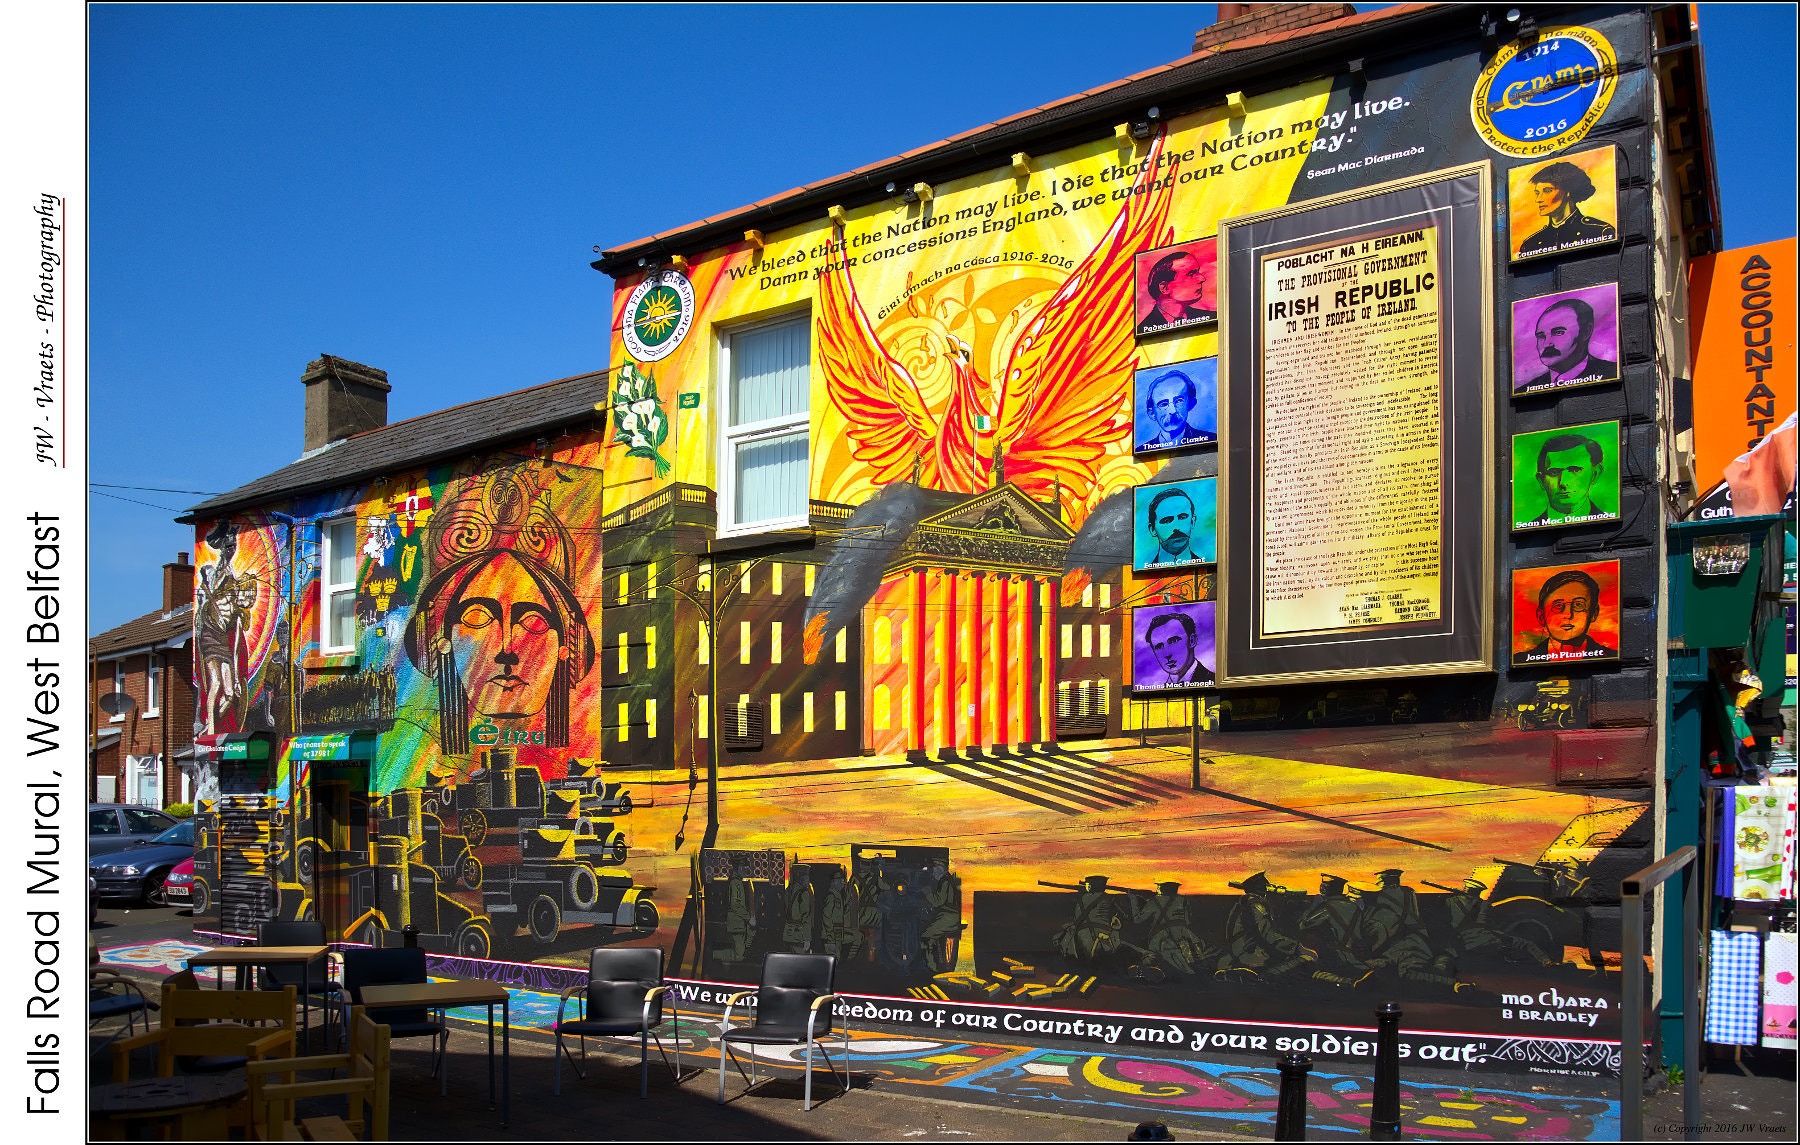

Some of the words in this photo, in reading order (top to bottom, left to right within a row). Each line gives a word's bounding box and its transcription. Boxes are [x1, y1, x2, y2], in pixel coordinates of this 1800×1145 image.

[1544, 30, 1564, 39] na
[1522, 41, 1560, 62] 1914
[1482, 127, 1529, 155] Protect
[1531, 143, 1556, 154] the
[1556, 101, 1605, 147] Republic
[1523, 119, 1568, 139] 2016
[1306, 165, 1336, 180] Sean
[1337, 159, 1363, 174] Mac
[1365, 146, 1425, 167] Diarmada
[724, 263, 757, 281] "We
[761, 250, 805, 272] bleed
[810, 237, 847, 260] that
[851, 229, 882, 250] the
[887, 211, 949, 239] Nation
[955, 200, 998, 223] may
[1003, 189, 1045, 209] live.
[1051, 181, 1057, 196] I
[1061, 174, 1094, 193] die
[1100, 163, 1149, 184] that
[1156, 148, 1195, 170] the
[1201, 129, 1284, 158] Nation
[1290, 110, 1347, 137] may
[1354, 94, 1411, 120] live.
[760, 269, 808, 291] Damn
[812, 258, 857, 280] your
[862, 227, 978, 264] concessions
[982, 203, 1068, 234] England,
[1072, 193, 1106, 212] we
[1111, 173, 1173, 202] want
[1179, 163, 1224, 185] our
[1230, 126, 1357, 171] Country."
[1278, 250, 1334, 271] POBLACHT
[1341, 246, 1355, 258] NA
[1362, 242, 1369, 254] H
[1375, 231, 1424, 251] EIREANN.
[1514, 243, 1558, 260] Countess
[902, 270, 942, 299] amach
[945, 263, 961, 275] na
[1002, 251, 1075, 270] 1916-2016
[1278, 278, 1295, 292] THE
[1301, 265, 1358, 288] PROVISIONAL
[1364, 250, 1428, 275] GOVERNMENT
[1268, 295, 1319, 321] IRISH
[1335, 273, 1434, 309] REPUBLIC
[1286, 320, 1297, 334] TO
[1303, 316, 1319, 331] THE
[1326, 309, 1356, 327] PEOPLE
[1362, 306, 1371, 319] OF
[1377, 297, 1418, 318] IRELAND.
[1526, 382, 1555, 392] James
[1556, 374, 1604, 387] Connolly
[1181, 435, 1209, 445] Clarke
[1515, 519, 1540, 529] Sean
[1541, 517, 1562, 526] Mac
[1564, 512, 1616, 524] Diarmada
[1526, 652, 1559, 662] Joseph
[1134, 683, 1165, 691] Thomas
[1165, 681, 1183, 689] Mac
[329, 740, 346, 749] speak
[674, 983, 711, 1002] "We
[920, 1008, 946, 1028] of
[952, 1011, 998, 1029] our
[1003, 1011, 1124, 1044] Country
[1130, 1024, 1184, 1044] and
[1190, 1030, 1268, 1063] your
[1418, 1041, 1488, 1064] out."
[1502, 1009, 1513, 1019] B
[1519, 1010, 1599, 1027] BRADLEY
